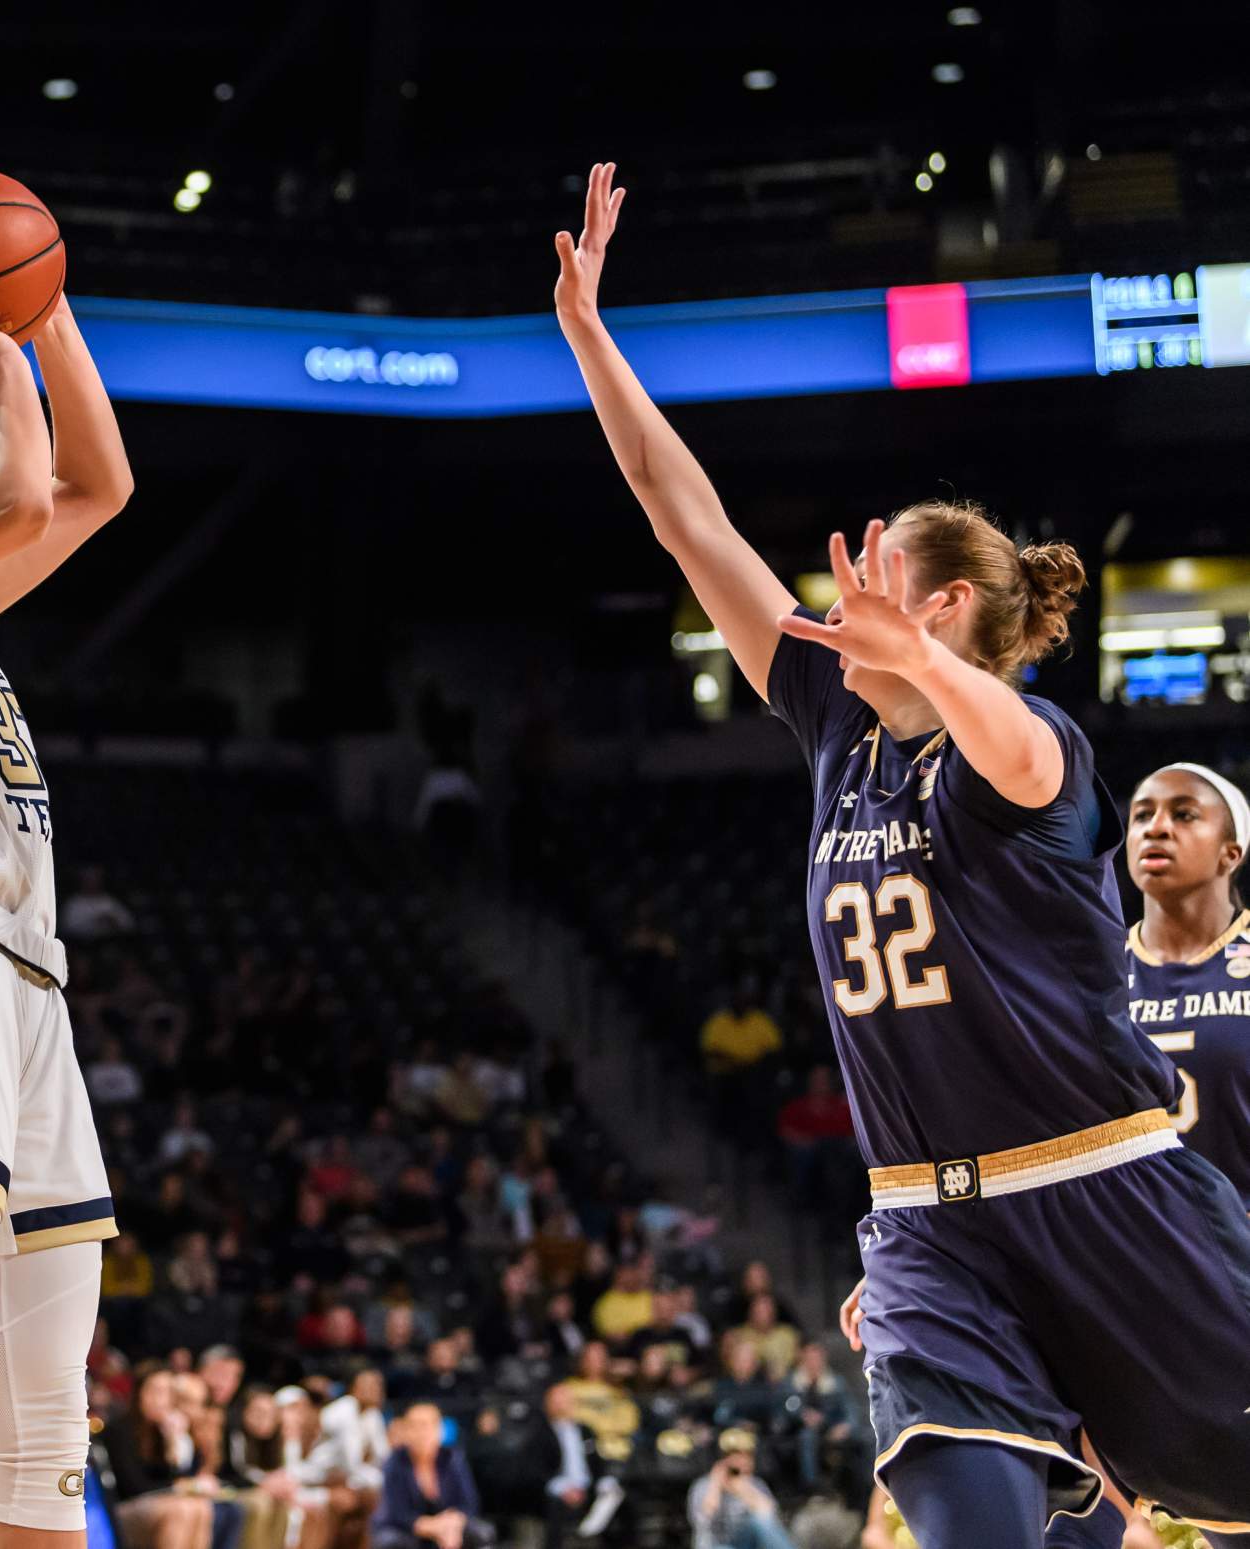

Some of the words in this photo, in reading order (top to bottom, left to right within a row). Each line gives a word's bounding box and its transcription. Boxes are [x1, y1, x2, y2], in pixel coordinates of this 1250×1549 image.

[825, 873, 952, 1017] 32
[1129, 998, 1178, 1024] TRE
[58, 1469, 84, 1497] G
